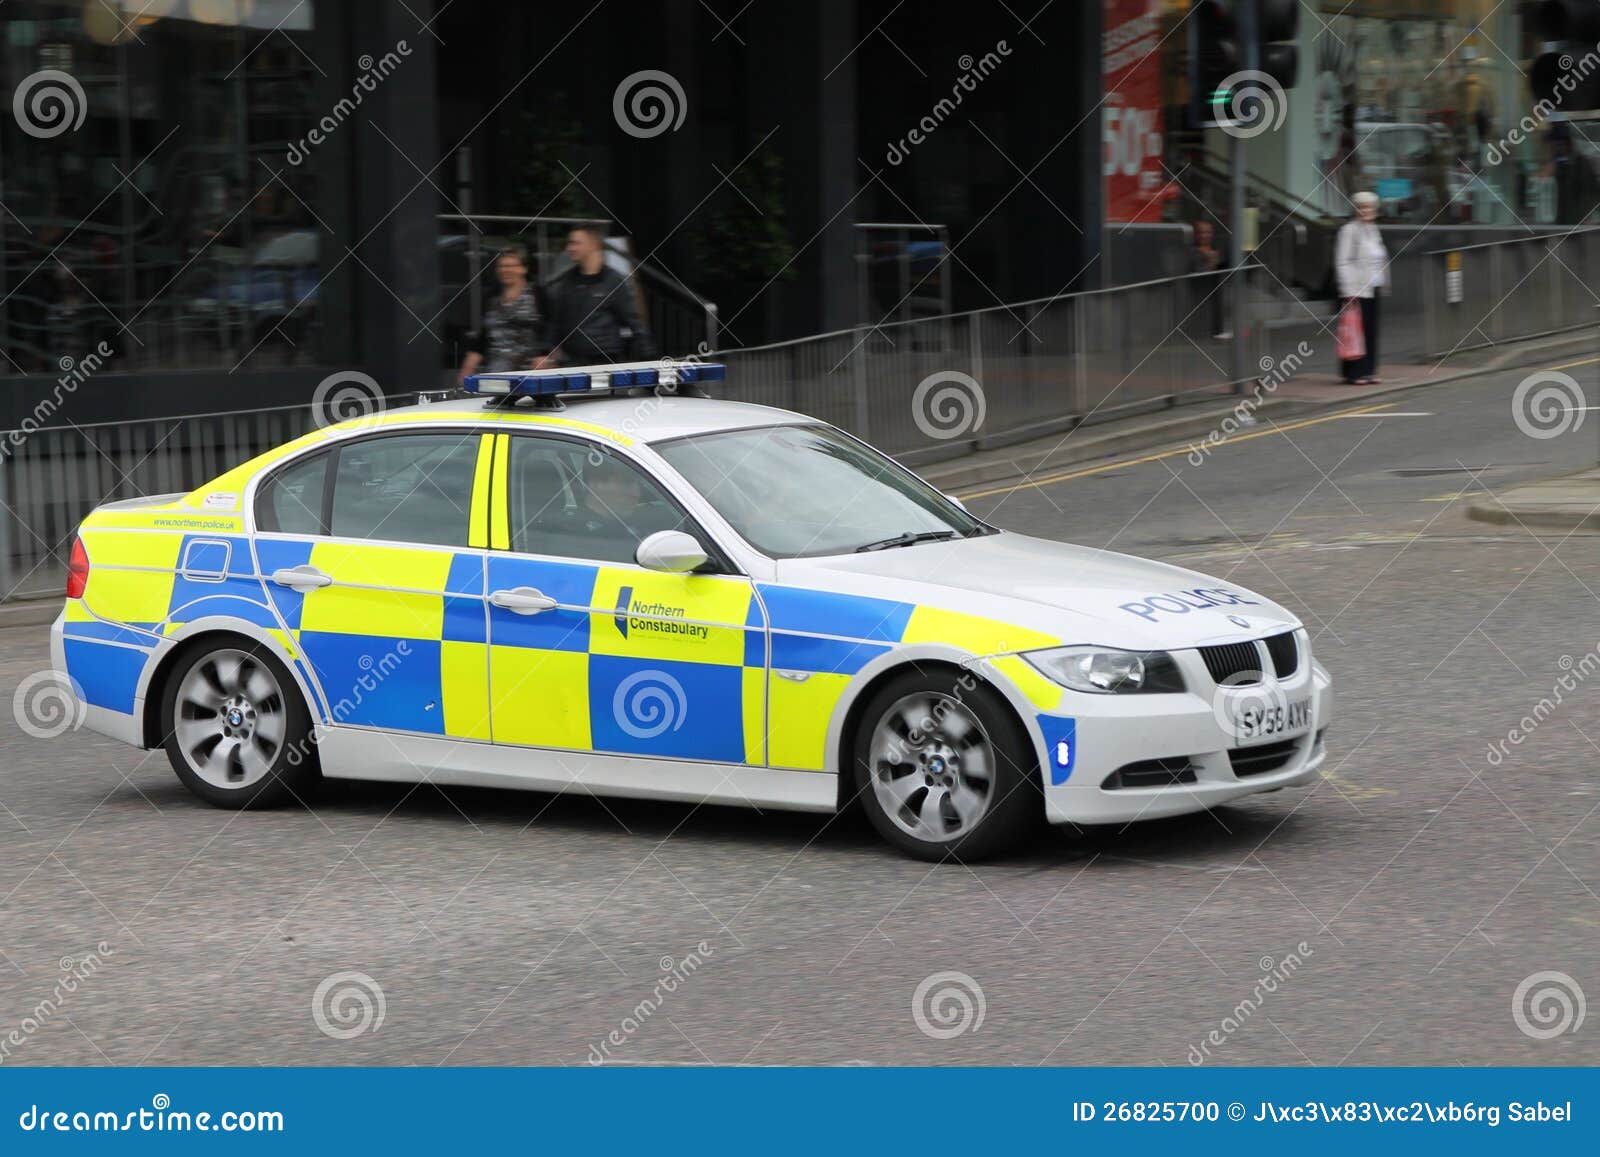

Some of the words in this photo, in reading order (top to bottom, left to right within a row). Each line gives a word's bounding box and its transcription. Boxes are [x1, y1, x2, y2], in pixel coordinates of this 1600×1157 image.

[153, 518, 235, 530] www.northern.police.uk
[631, 600, 685, 618] Northern
[1118, 588, 1261, 623] POLICE
[630, 617, 709, 639] Constabulary
